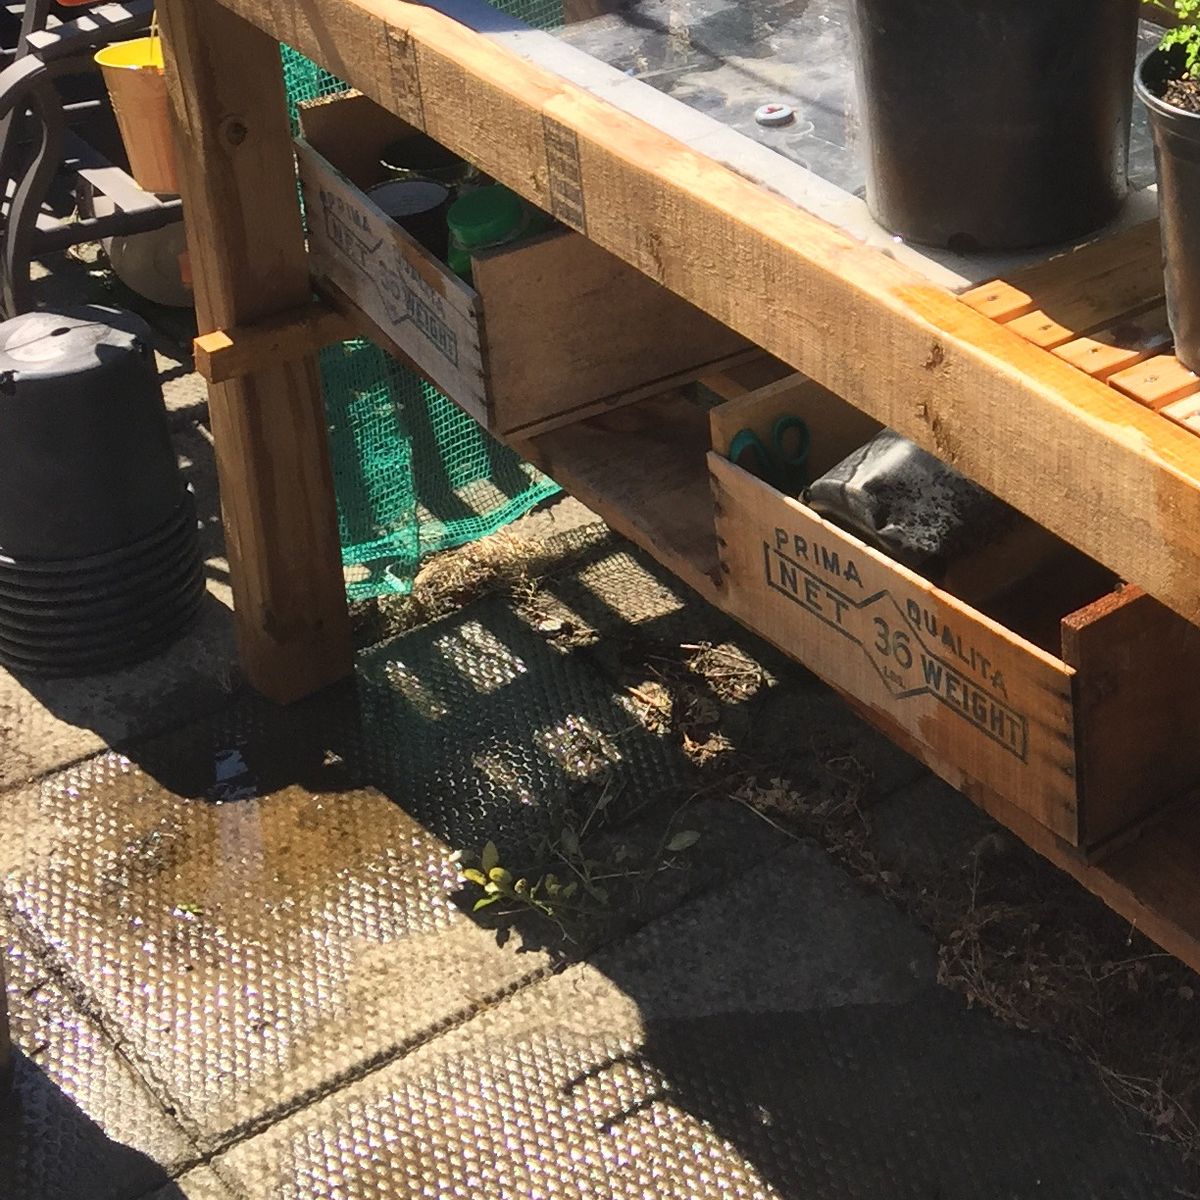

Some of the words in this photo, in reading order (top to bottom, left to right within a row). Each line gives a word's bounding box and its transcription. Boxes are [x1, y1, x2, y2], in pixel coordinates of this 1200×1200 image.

[407, 291, 457, 362] WEIGHT
[774, 526, 864, 589] PRIMA
[907, 598, 1009, 700] QUALITA
[780, 559, 850, 625] NET
[873, 616, 914, 670] 36
[920, 653, 1022, 751] WEIGHT
